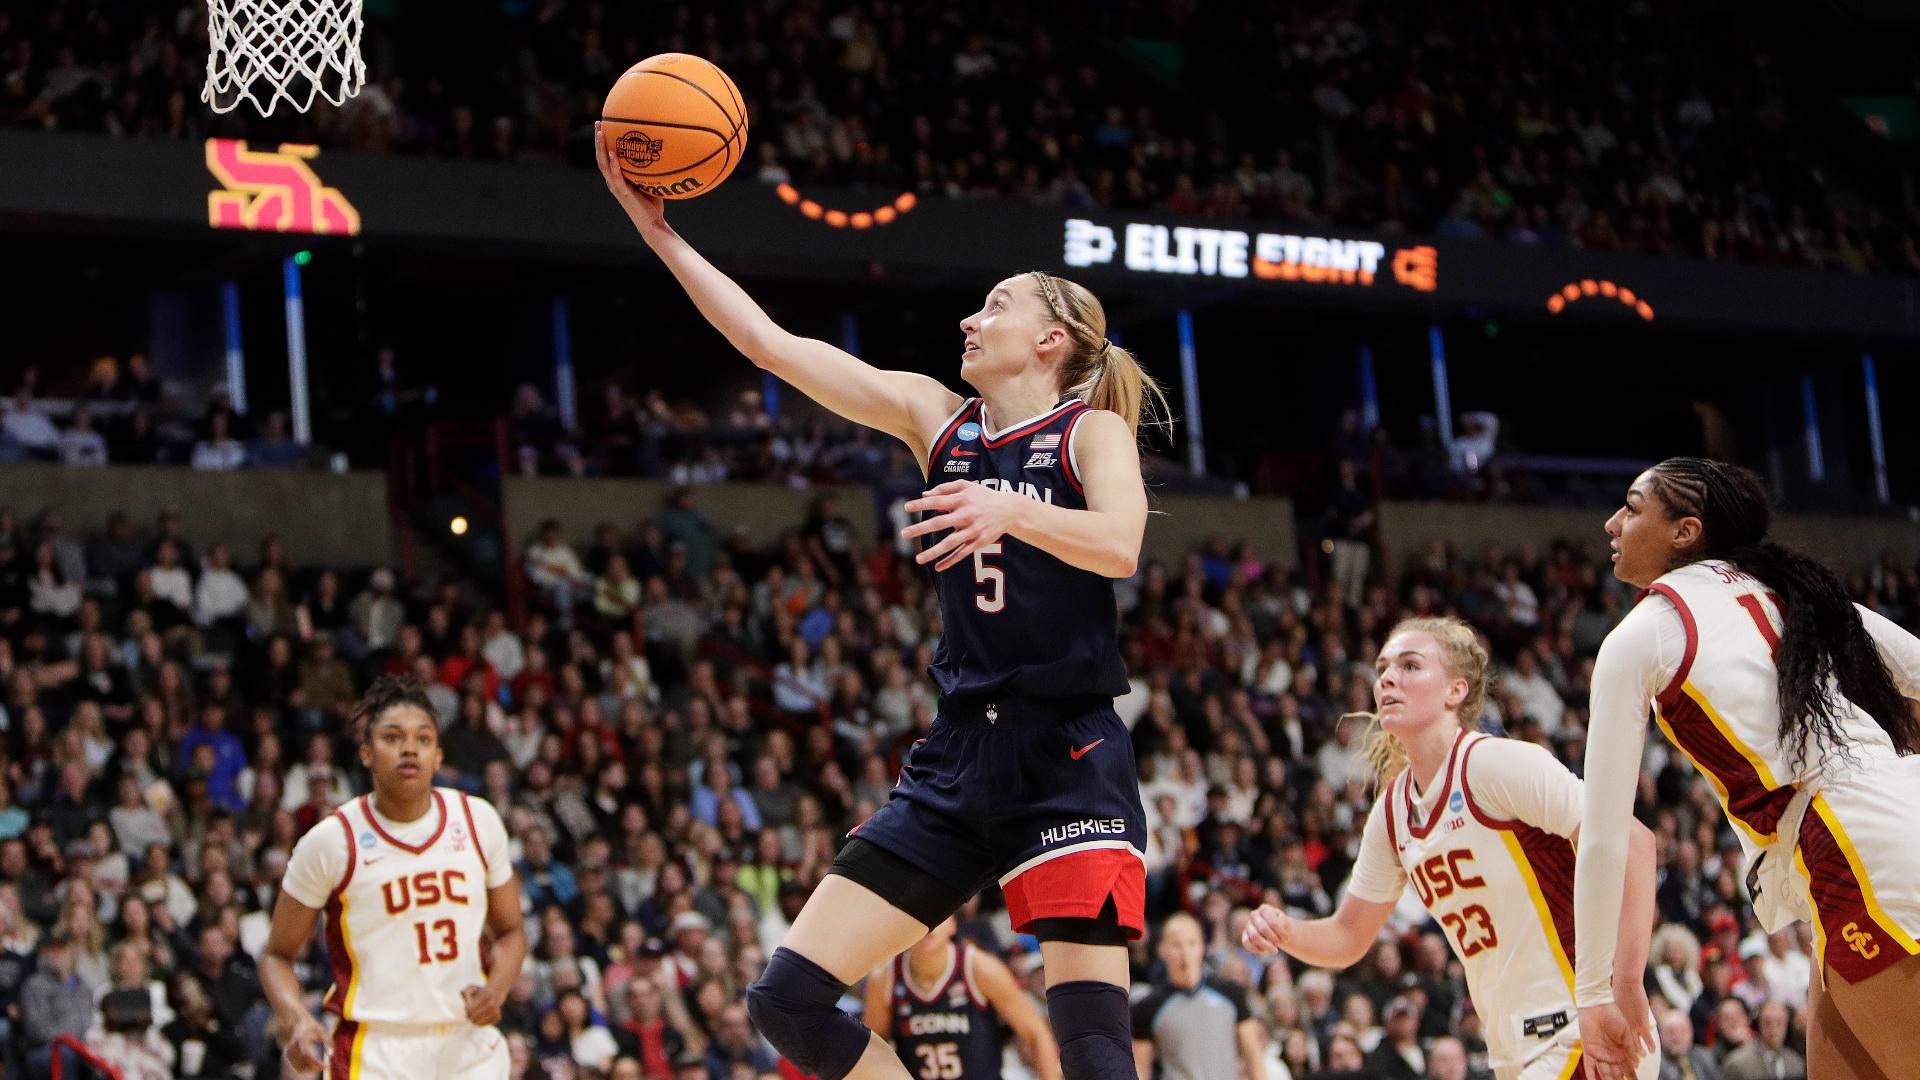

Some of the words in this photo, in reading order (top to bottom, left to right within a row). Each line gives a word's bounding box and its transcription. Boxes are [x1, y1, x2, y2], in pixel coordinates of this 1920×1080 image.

[1124, 223, 1249, 278] ELITE
[1253, 233, 1385, 286] EIGHT
[943, 465, 970, 473] CHANGE
[1031, 452, 1053, 460] BIG
[973, 541, 1007, 614] 5
[1040, 818, 1126, 847] HUSKIES
[380, 869, 470, 917] USC
[1410, 848, 1488, 910] USC
[413, 918, 459, 966] 13
[1440, 903, 1499, 958] 23
[915, 1042, 963, 1080] 35
